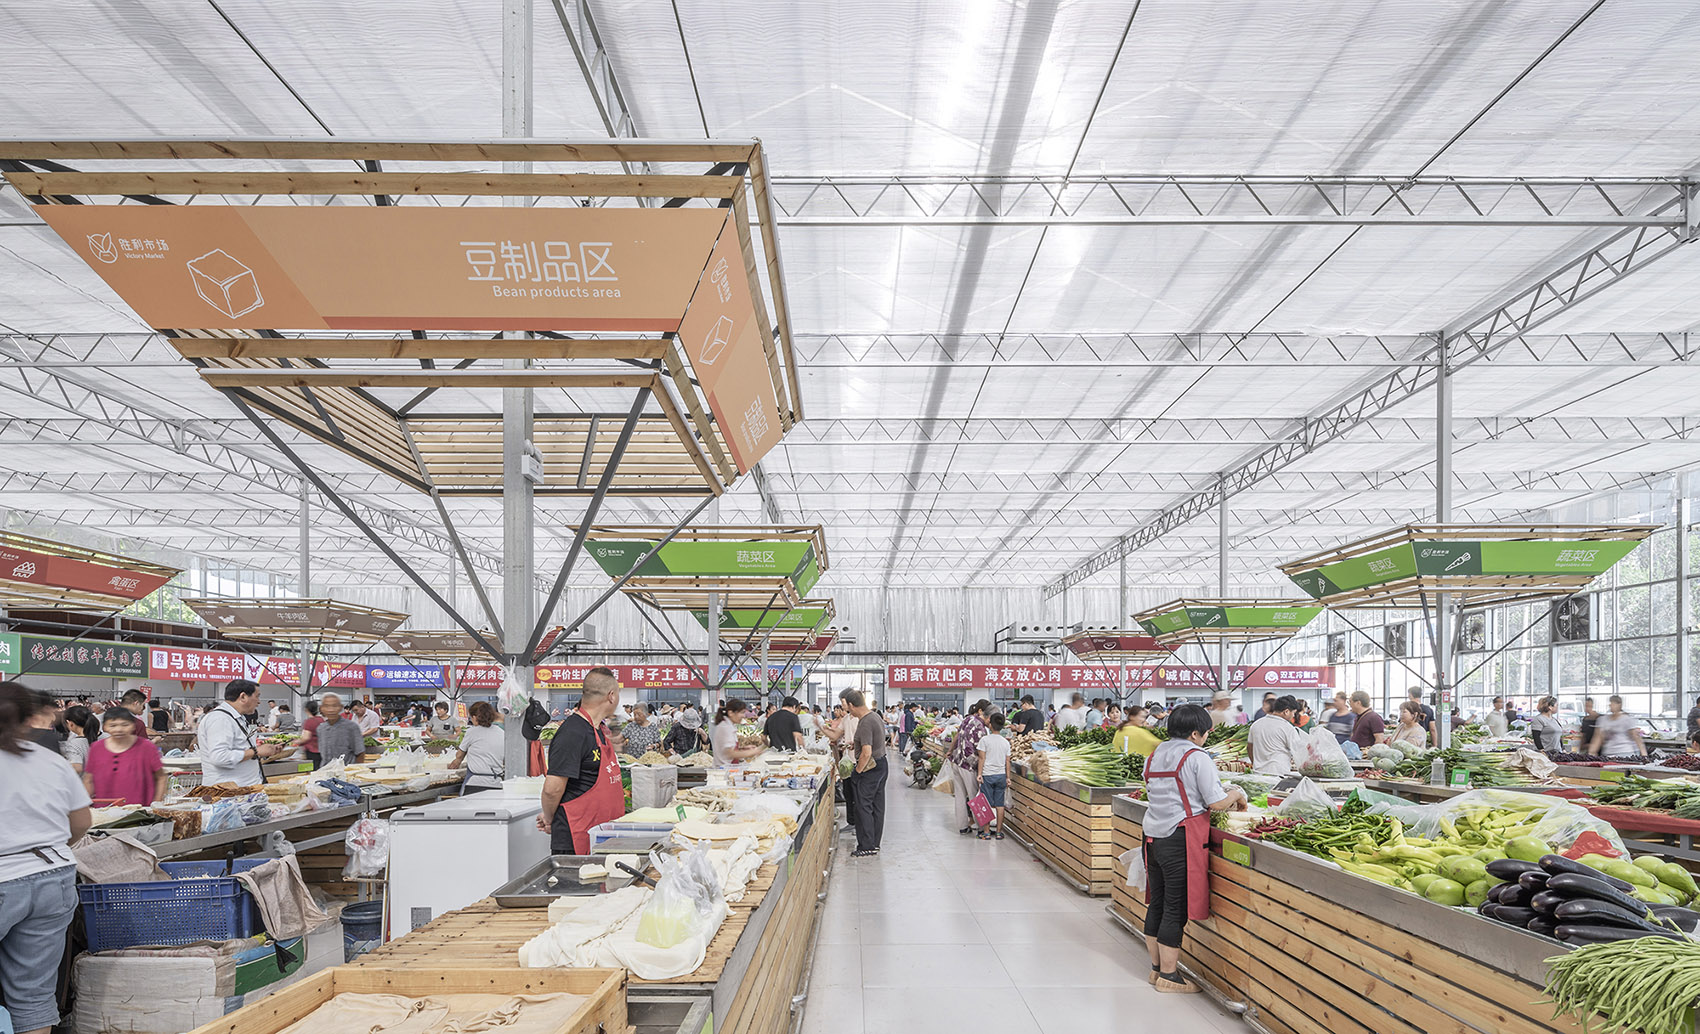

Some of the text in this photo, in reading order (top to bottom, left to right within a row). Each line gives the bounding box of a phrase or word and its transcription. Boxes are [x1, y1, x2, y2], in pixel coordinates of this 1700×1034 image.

[118, 238, 169, 252] 胜利市场
[124, 252, 165, 261] Victory Market
[459, 239, 619, 283] 豆制品区
[492, 285, 621, 300] Bean products area
[736, 550, 775, 563] 蔬菜区
[1555, 550, 1600, 563] 蔬菜区
[170, 652, 243, 673] 马敬牛羊肉
[894, 667, 973, 682] 胡家放心肉
[984, 667, 1060, 682] 海友放心肉
[1166, 669, 1244, 682] 诚信放心店
